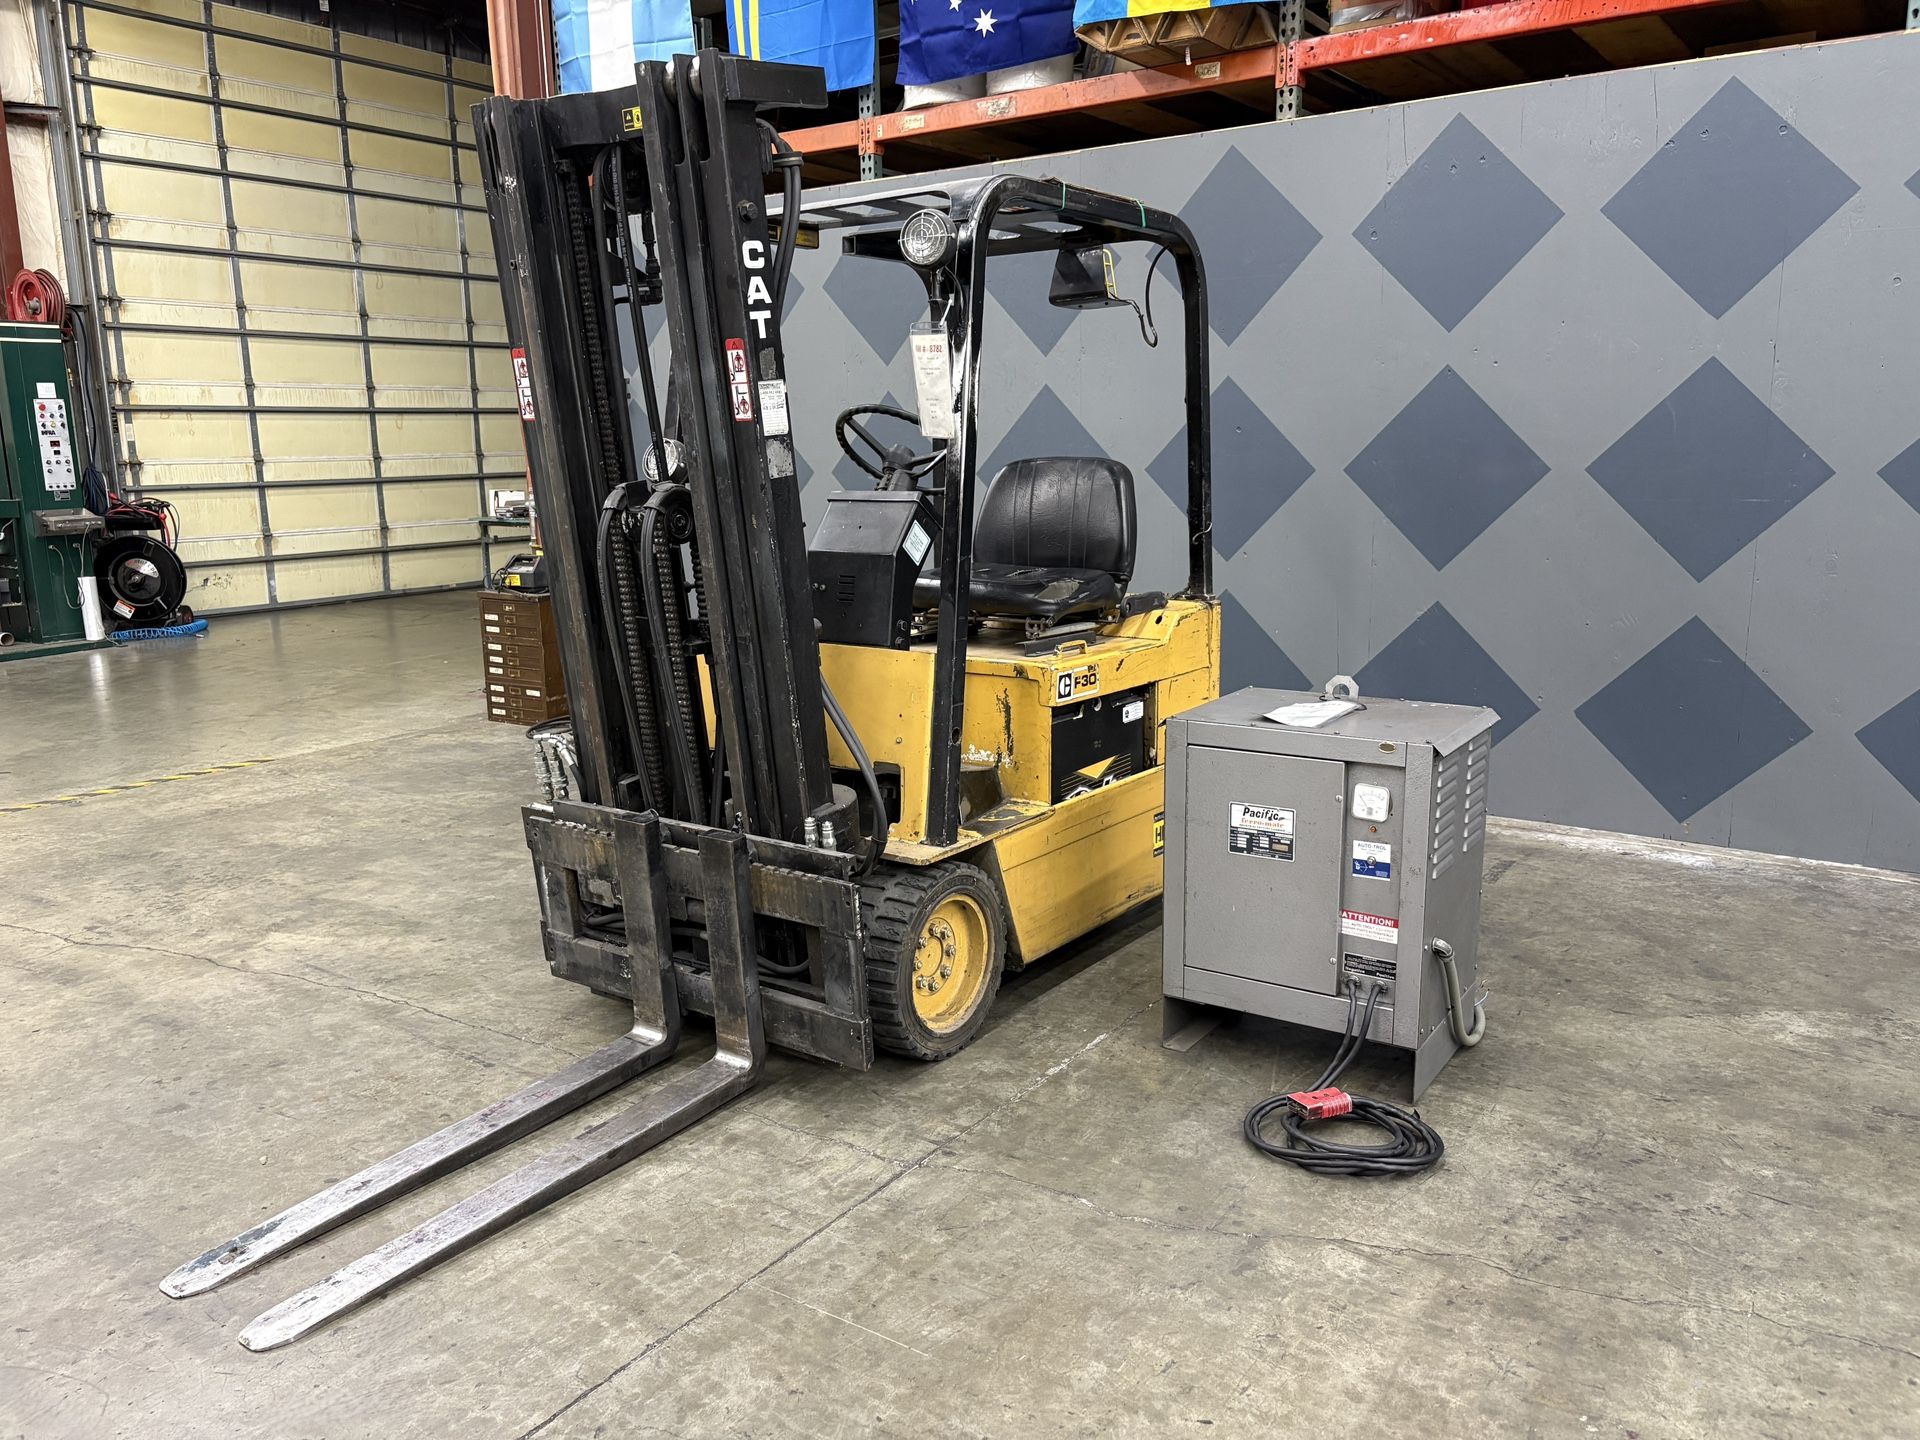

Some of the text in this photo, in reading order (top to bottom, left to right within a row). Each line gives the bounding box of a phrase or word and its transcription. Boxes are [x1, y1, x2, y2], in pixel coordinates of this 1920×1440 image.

[742, 240, 773, 339] CAT
[929, 345, 943, 353] 8782
[1074, 673, 1097, 688] F30
[1243, 807, 1279, 821] Pacific
[1342, 911, 1394, 927] ATTENTION!
